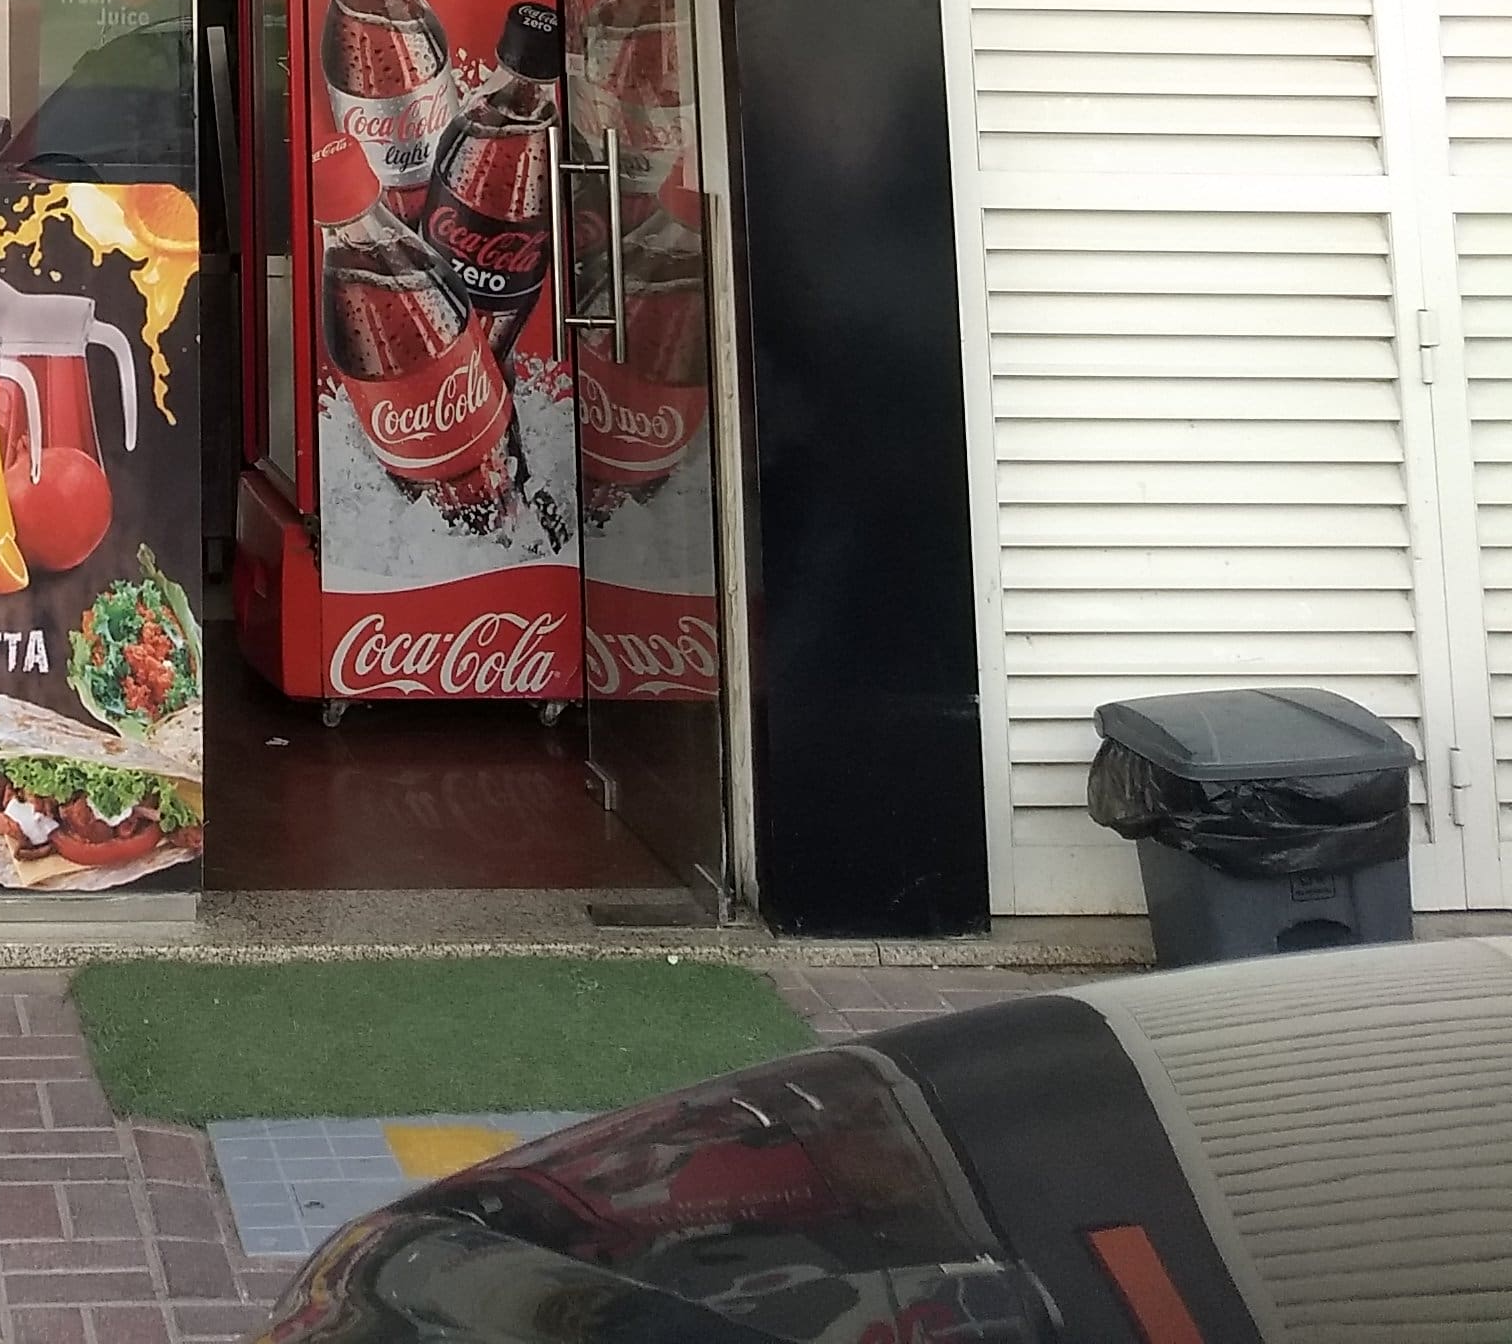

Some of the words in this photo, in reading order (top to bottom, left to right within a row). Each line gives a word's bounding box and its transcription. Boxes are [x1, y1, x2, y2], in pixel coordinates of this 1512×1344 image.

[522, 16, 553, 33] zero
[385, 142, 431, 173] light
[449, 258, 507, 293] zero
